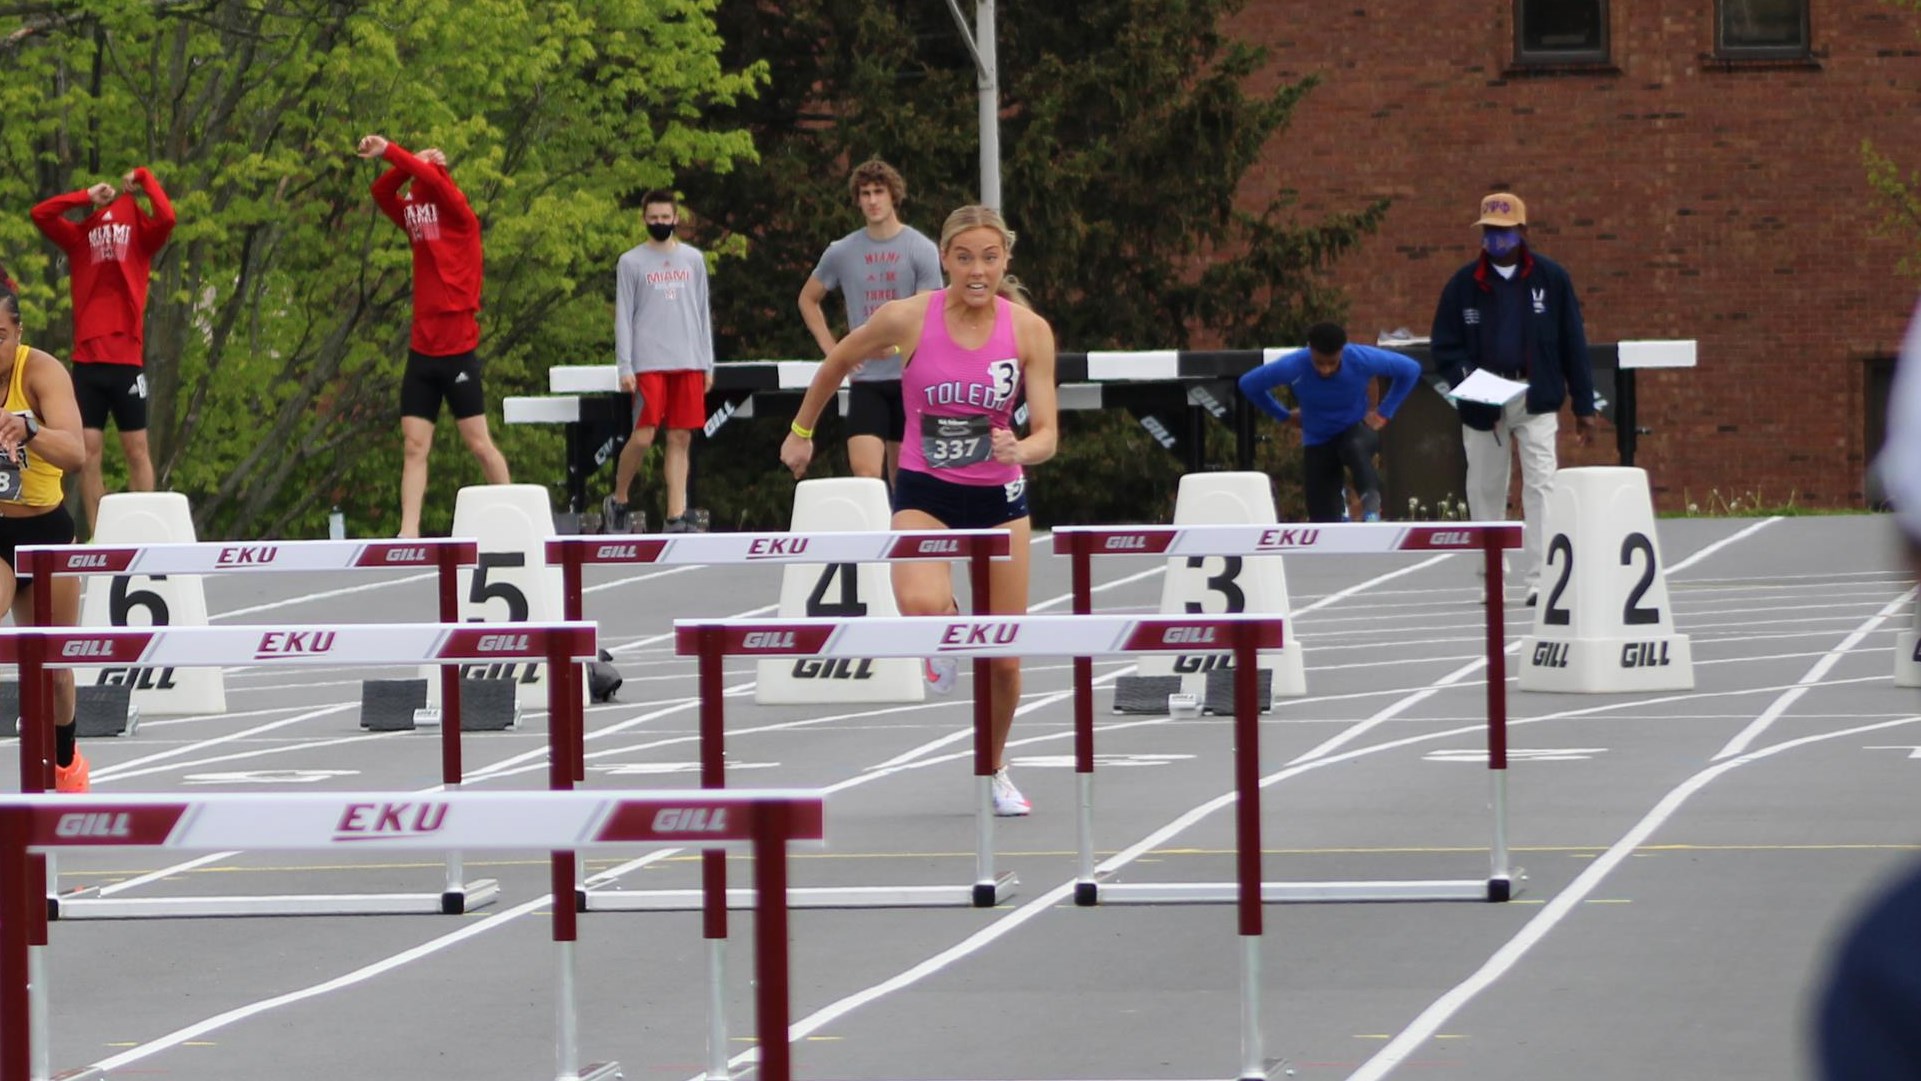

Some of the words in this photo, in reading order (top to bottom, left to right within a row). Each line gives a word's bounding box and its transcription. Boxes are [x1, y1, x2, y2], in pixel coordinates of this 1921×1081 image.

[999, 362, 1015, 398] 3
[924, 382, 1007, 411] TOLED
[704, 400, 735, 437] GILL
[934, 438, 980, 459] 337
[596, 545, 637, 559] GILL
[748, 538, 809, 555] EKU
[918, 539, 958, 553] GILL
[1105, 535, 1146, 549] GILL
[1258, 529, 1320, 546] EKU
[1430, 531, 1470, 545] GILL
[67, 554, 107, 568] GILL
[218, 547, 278, 564] EKU
[385, 547, 426, 562] GILL
[467, 552, 529, 622] 5
[806, 563, 867, 617] 4
[1185, 556, 1246, 614] 3
[1544, 533, 1573, 625] 2
[1620, 532, 1660, 625] 2
[109, 575, 169, 627] 6
[62, 639, 113, 657] GILL
[258, 631, 337, 653] EKU
[477, 634, 528, 652] GILL
[742, 631, 795, 649] GILL
[941, 623, 1020, 645] EKU
[1162, 626, 1215, 644] GILL
[1173, 655, 1237, 674] GIL
[1532, 641, 1569, 668] GILL
[1621, 640, 1670, 668] GILL
[96, 667, 176, 690] GILL
[791, 658, 873, 679] GILL
[56, 813, 129, 837] GILL
[337, 803, 450, 832] EKU
[652, 808, 726, 832] GILL
